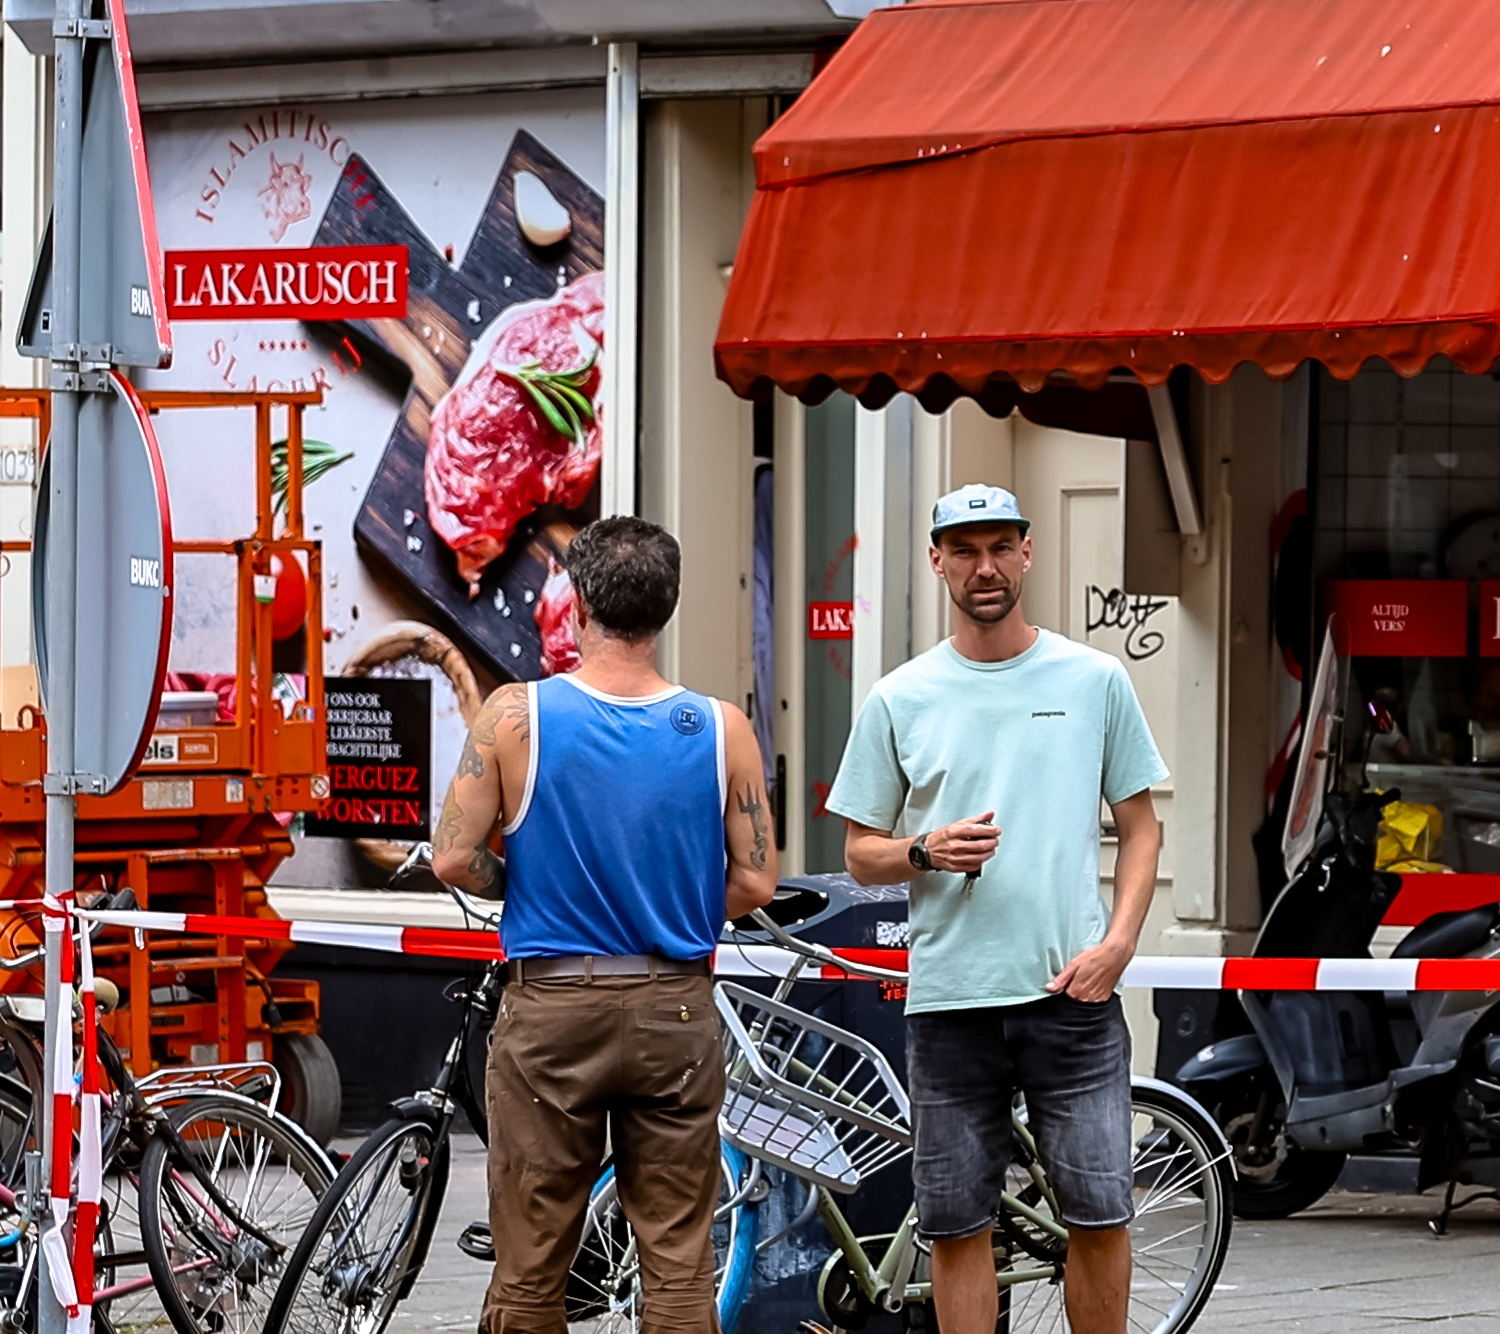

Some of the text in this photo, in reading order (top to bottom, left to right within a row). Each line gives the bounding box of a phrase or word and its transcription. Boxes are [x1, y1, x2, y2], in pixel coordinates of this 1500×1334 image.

[172, 260, 398, 307] LAKARUSCH
[1371, 604, 1410, 619] ALTIJD
[329, 765, 419, 792] ERGUEZ
